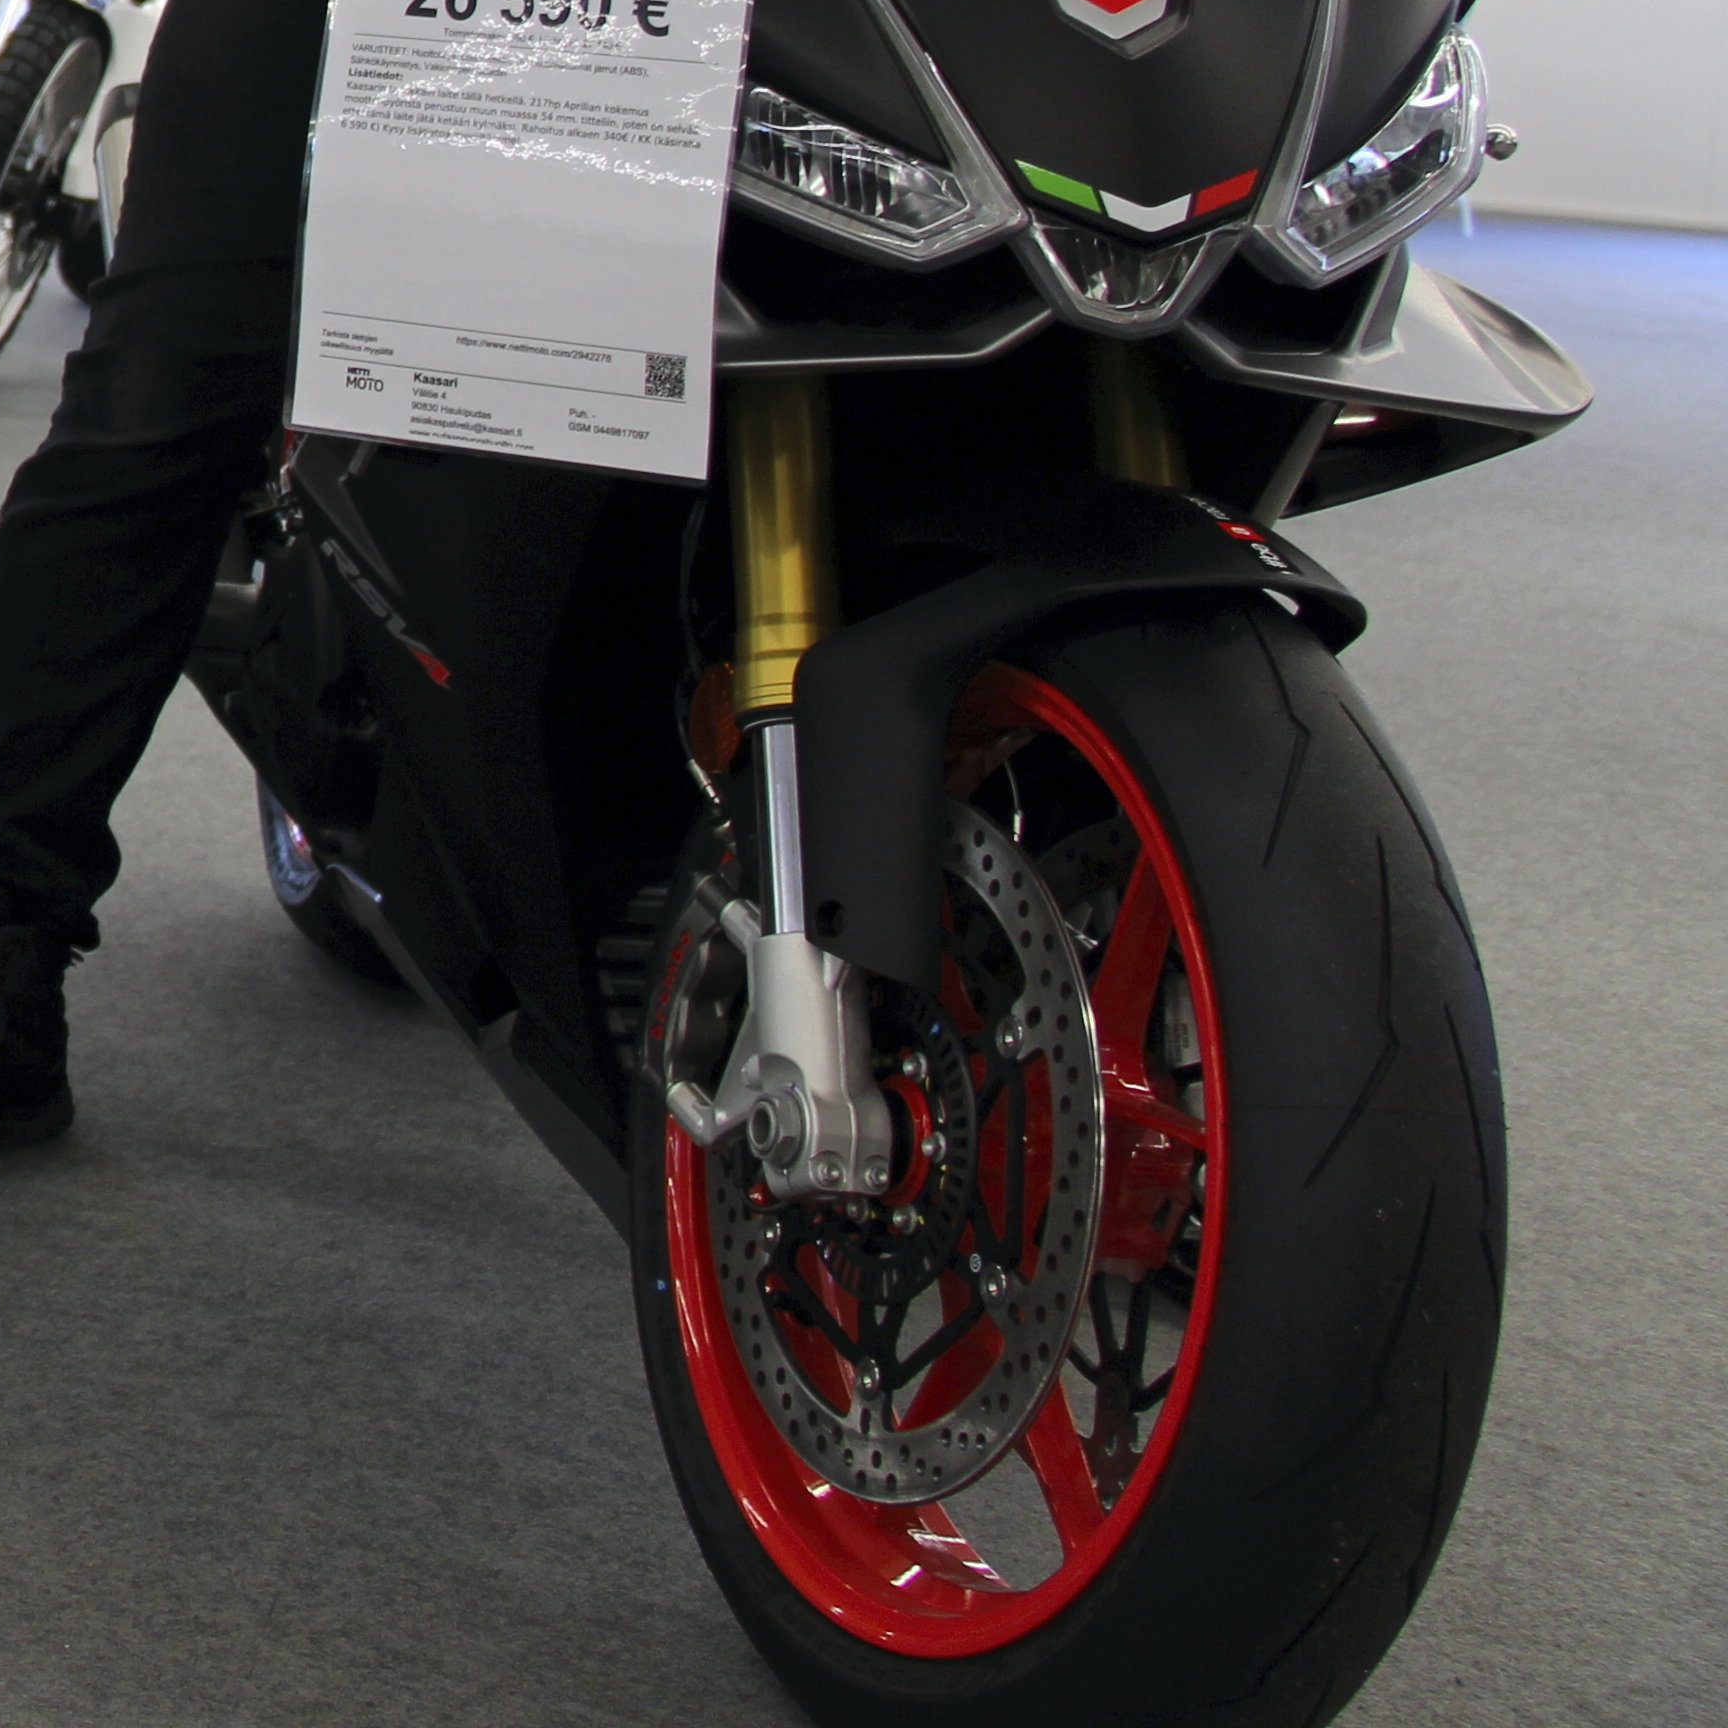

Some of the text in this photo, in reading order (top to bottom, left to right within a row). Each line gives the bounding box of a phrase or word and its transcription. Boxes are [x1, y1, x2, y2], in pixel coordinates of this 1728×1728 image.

[347, 67, 404, 81] Lisätiedot:
[437, 88, 459, 99] laite
[530, 96, 561, 110] 217hp
[562, 100, 602, 113] Aprilian
[603, 104, 650, 117] kokemus
[423, 98, 468, 114] perustuu
[469, 106, 497, 116] muun
[499, 108, 538, 120] muassa
[620, 118, 649, 132] joten
[382, 124, 405, 136] Kysy
[393, 112, 414, 122] laite
[521, 122, 564, 136] Rahoitus
[566, 128, 601, 140] alkaen
[345, 376, 384, 393] MOTO
[412, 371, 458, 388] Kaasari
[567, 421, 592, 434] GSM
